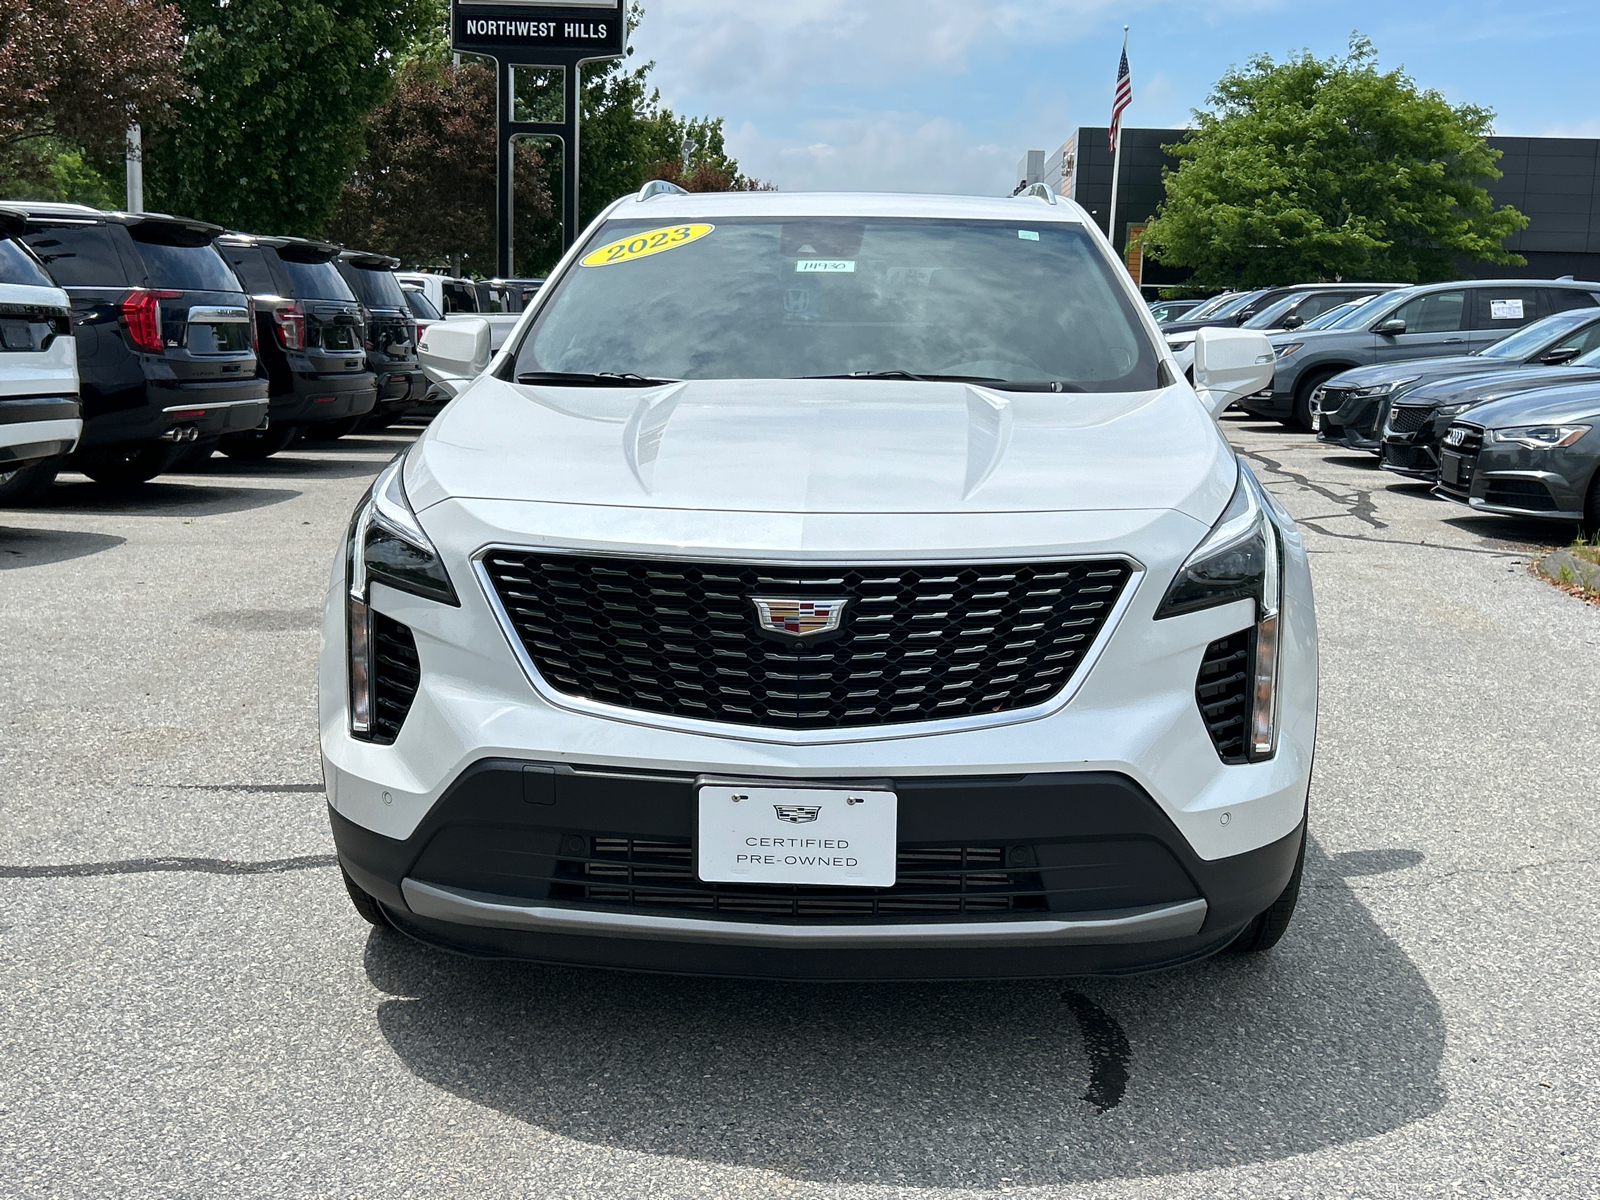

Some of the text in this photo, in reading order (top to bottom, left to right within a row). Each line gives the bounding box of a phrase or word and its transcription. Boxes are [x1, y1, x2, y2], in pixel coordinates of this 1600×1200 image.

[466, 19, 607, 38] NORTHWEST HILLS
[606, 227, 691, 262] 2023
[745, 837, 849, 849] CERTIFIED
[736, 854, 858, 867] PRE-OWNED
